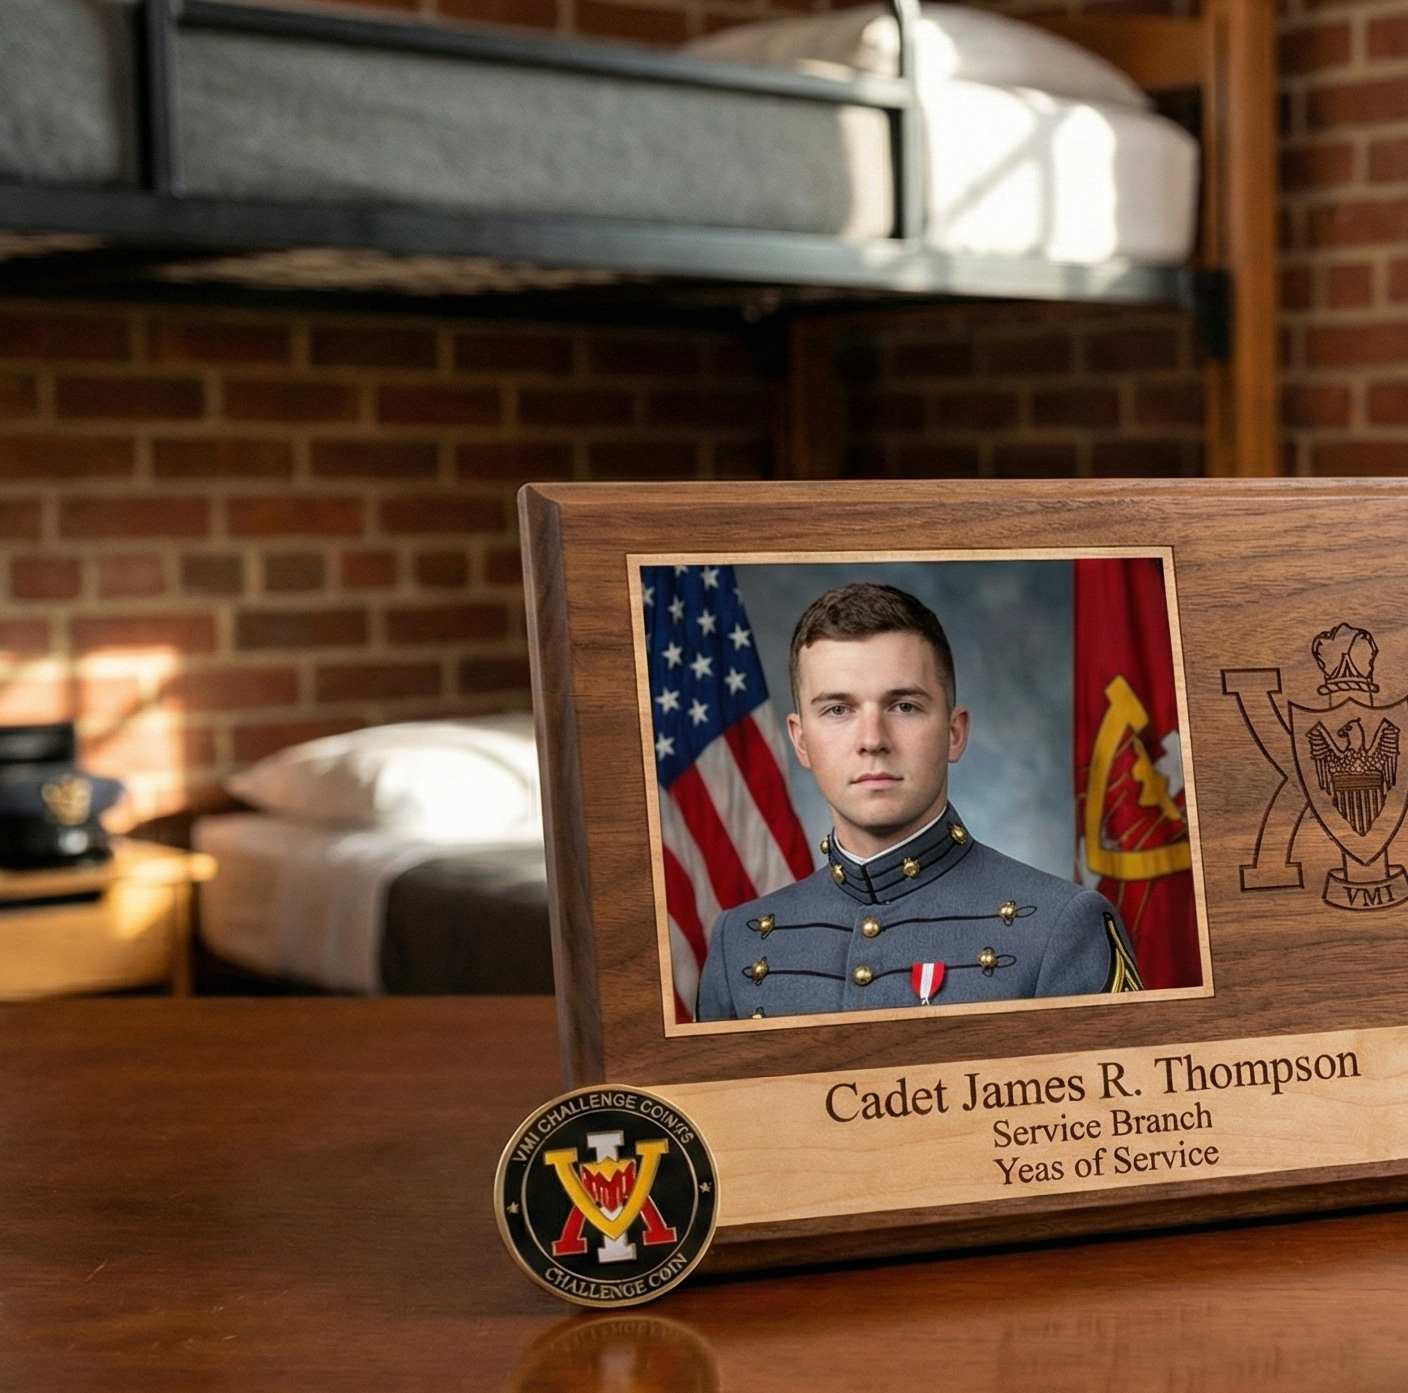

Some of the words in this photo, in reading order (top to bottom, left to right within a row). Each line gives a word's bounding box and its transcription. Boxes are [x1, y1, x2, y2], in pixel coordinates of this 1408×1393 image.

[1343, 885, 1396, 906] VMI
[825, 1077, 949, 1123] Cadet
[962, 1073, 1085, 1112] James
[1097, 1062, 1142, 1100] R.
[1154, 1050, 1361, 1095] Thompson
[514, 1127, 541, 1162] VMI
[538, 1093, 637, 1132] CHALLENGE
[993, 1114, 1102, 1148] Service
[1110, 1102, 1213, 1137] Branch
[993, 1156, 1065, 1185] Yeas
[1074, 1147, 1107, 1178] of
[1113, 1140, 1219, 1173] Service
[545, 1267, 648, 1300] CHALLENGE
[649, 1253, 687, 1287] COIN
